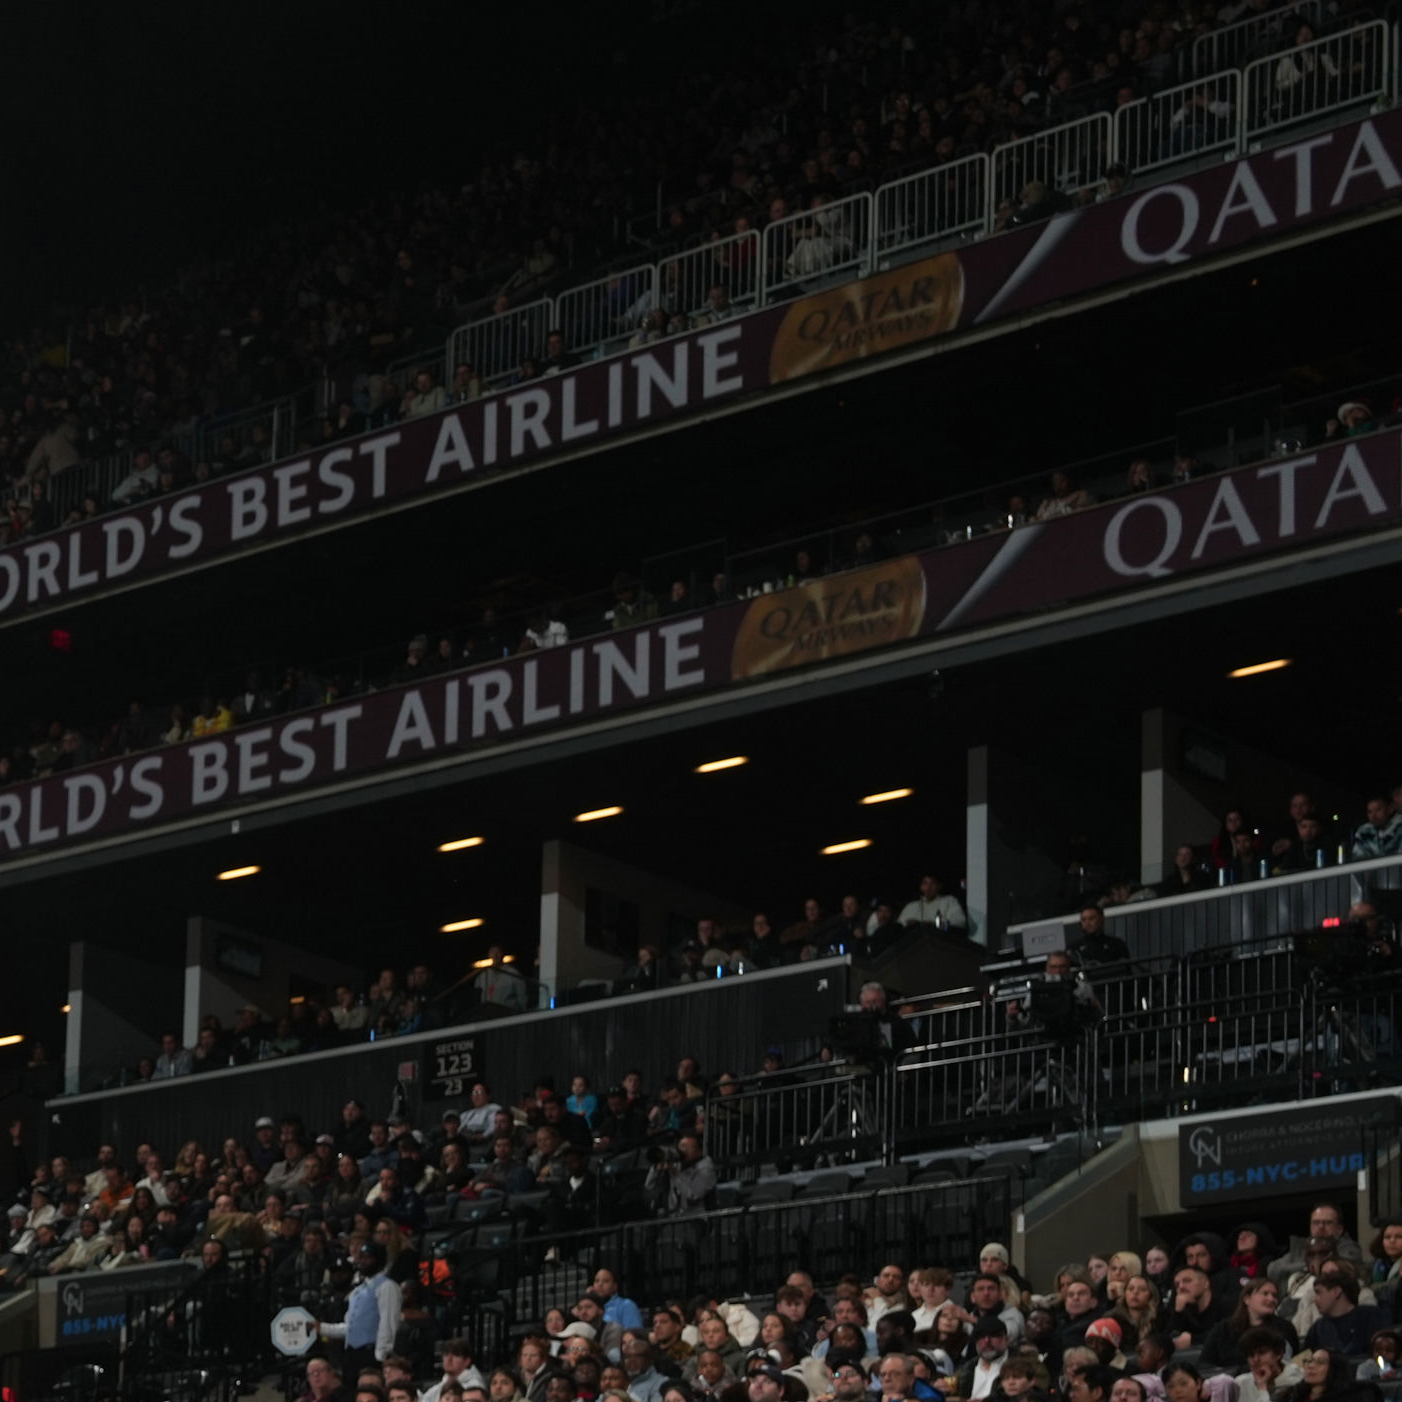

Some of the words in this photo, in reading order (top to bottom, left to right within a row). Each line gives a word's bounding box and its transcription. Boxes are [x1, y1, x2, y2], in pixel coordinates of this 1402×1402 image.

[1120, 119, 1402, 264] QATA
[797, 272, 938, 344] QATAR
[228, 431, 400, 541] BEST
[427, 324, 743, 481] AIRLINE
[1104, 443, 1387, 578] QATA
[758, 576, 898, 643] QATAR
[191, 705, 364, 807] BEST
[386, 618, 707, 759] AIRLINE
[437, 1052, 473, 1077] 123
[444, 1080, 463, 1096] 23
[1190, 1152, 1364, 1193] 855-NYC-HUR
[62, 1313, 127, 1336] 855-NYC
